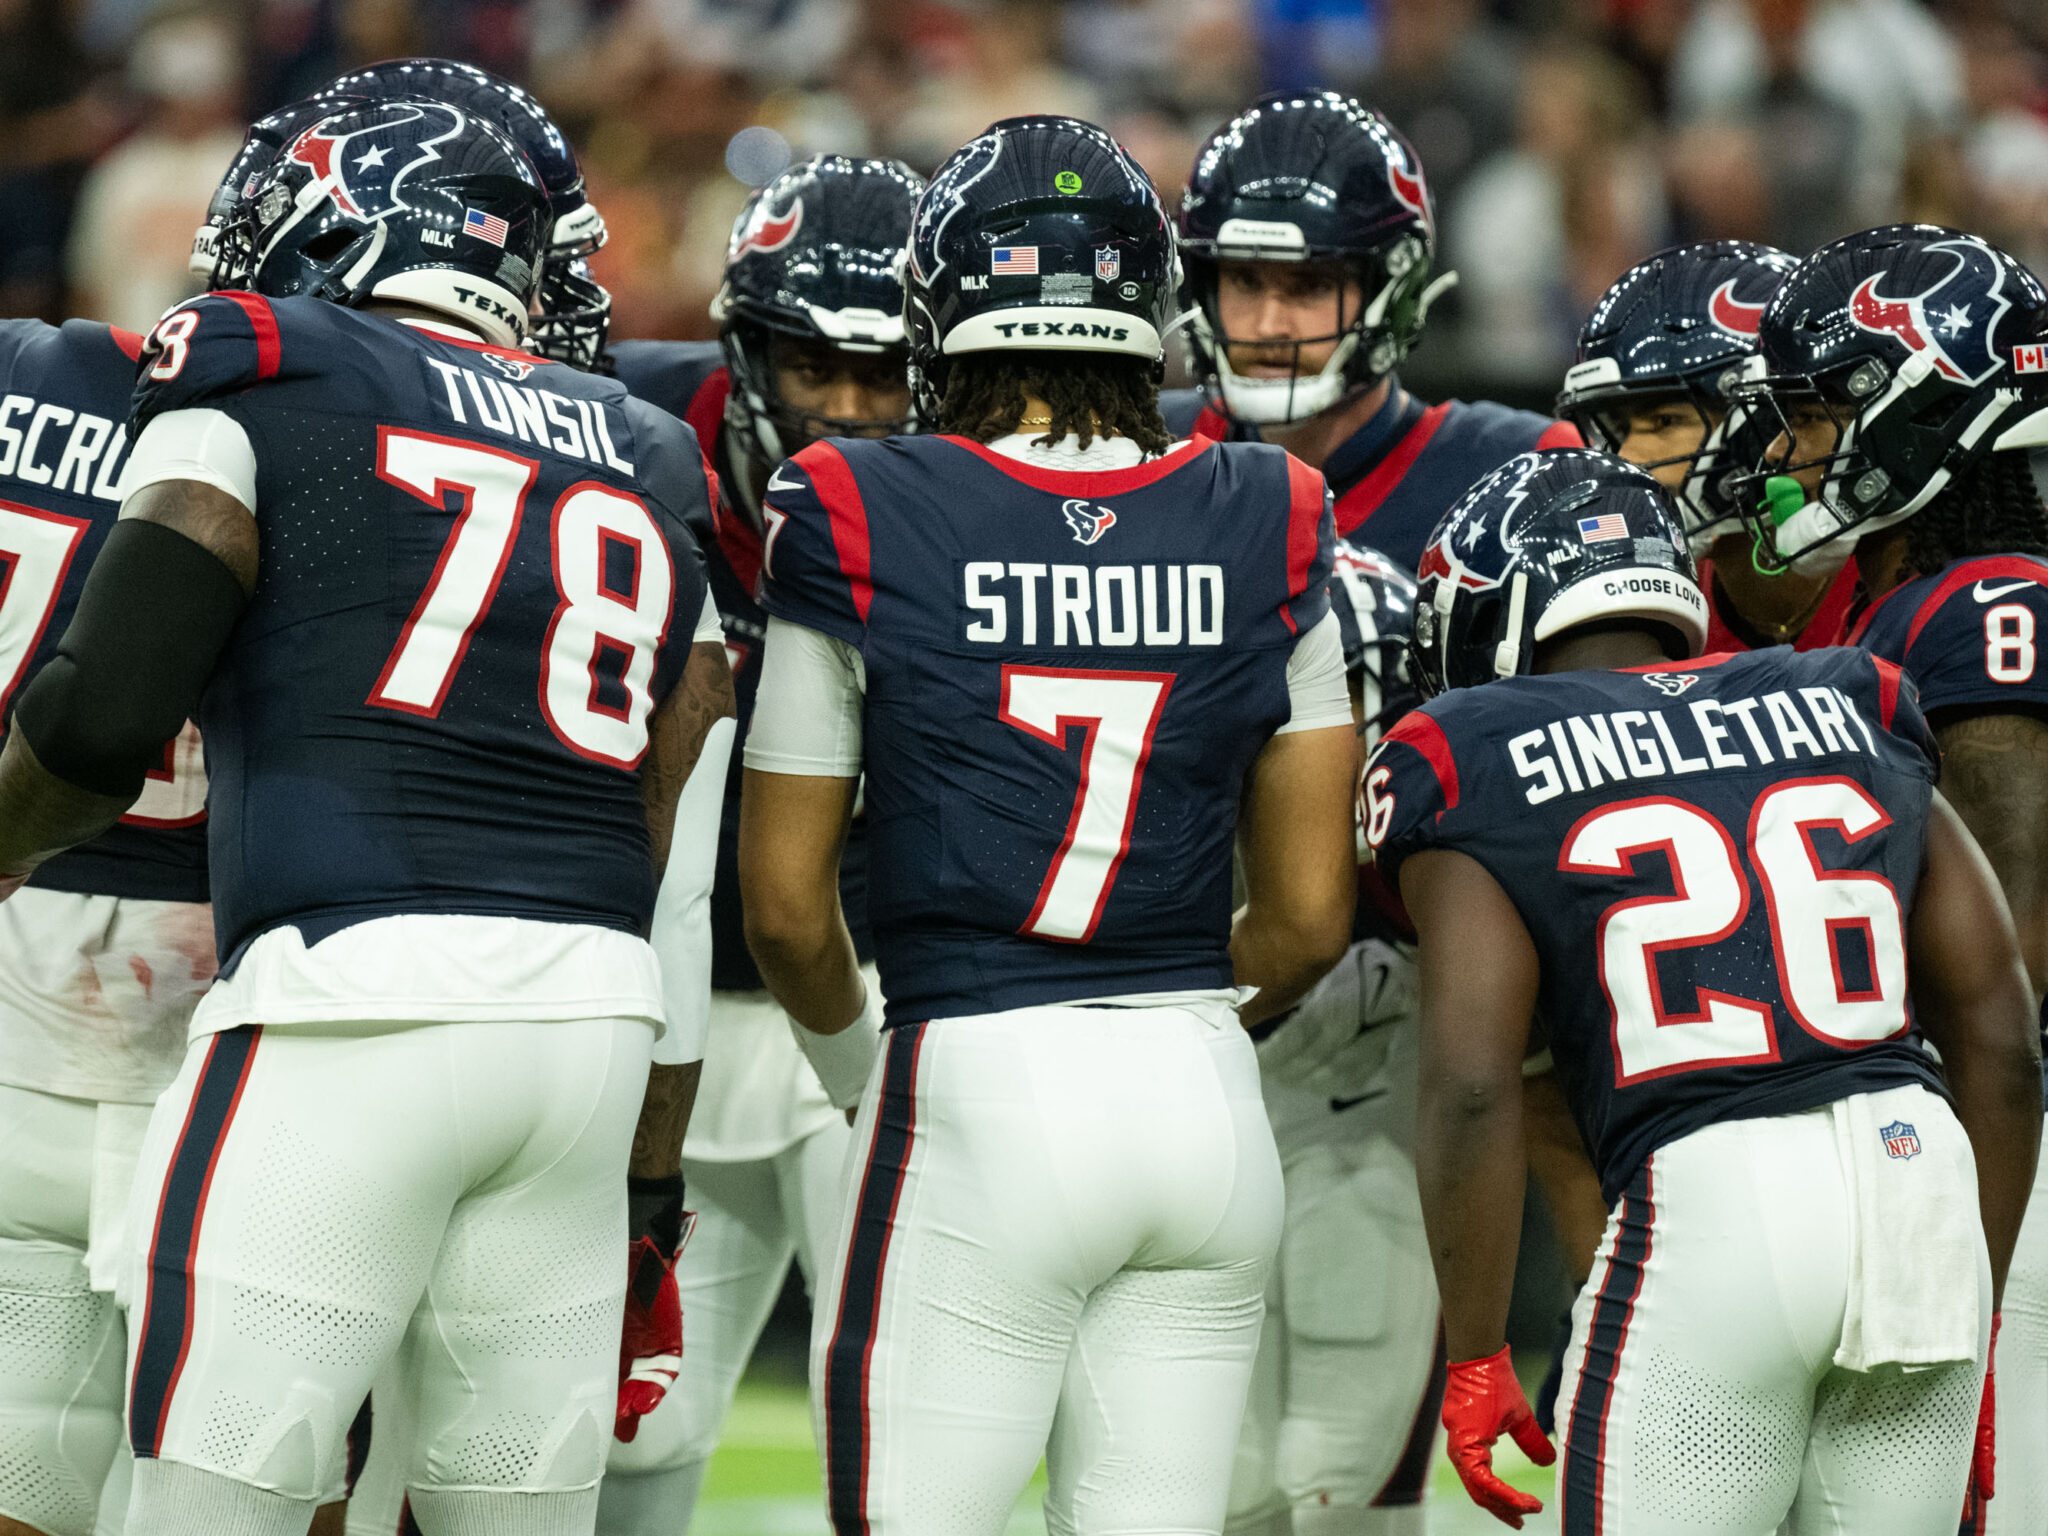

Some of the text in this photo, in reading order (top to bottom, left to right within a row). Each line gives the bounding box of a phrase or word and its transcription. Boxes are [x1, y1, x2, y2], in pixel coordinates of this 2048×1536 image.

[421, 228, 456, 249] MLK
[1100, 262, 1117, 275] NFL
[960, 275, 989, 290] MLK
[144, 310, 200, 382] 8
[994, 322, 1129, 341] TEXANS
[427, 356, 635, 477] TUNSIL
[763, 499, 790, 580] 7
[1546, 544, 1581, 566] MLK
[367, 424, 676, 771] 78
[964, 562, 1224, 646] STROUD
[1604, 579, 1701, 610] CHOOSE LOVE
[1983, 603, 2037, 684] 8
[1508, 686, 1878, 805] SINGLETARY
[999, 664, 1177, 944] 7
[1361, 765, 1396, 848] 6
[1557, 775, 1909, 1088] 26
[1887, 1137, 1919, 1156] NFL
